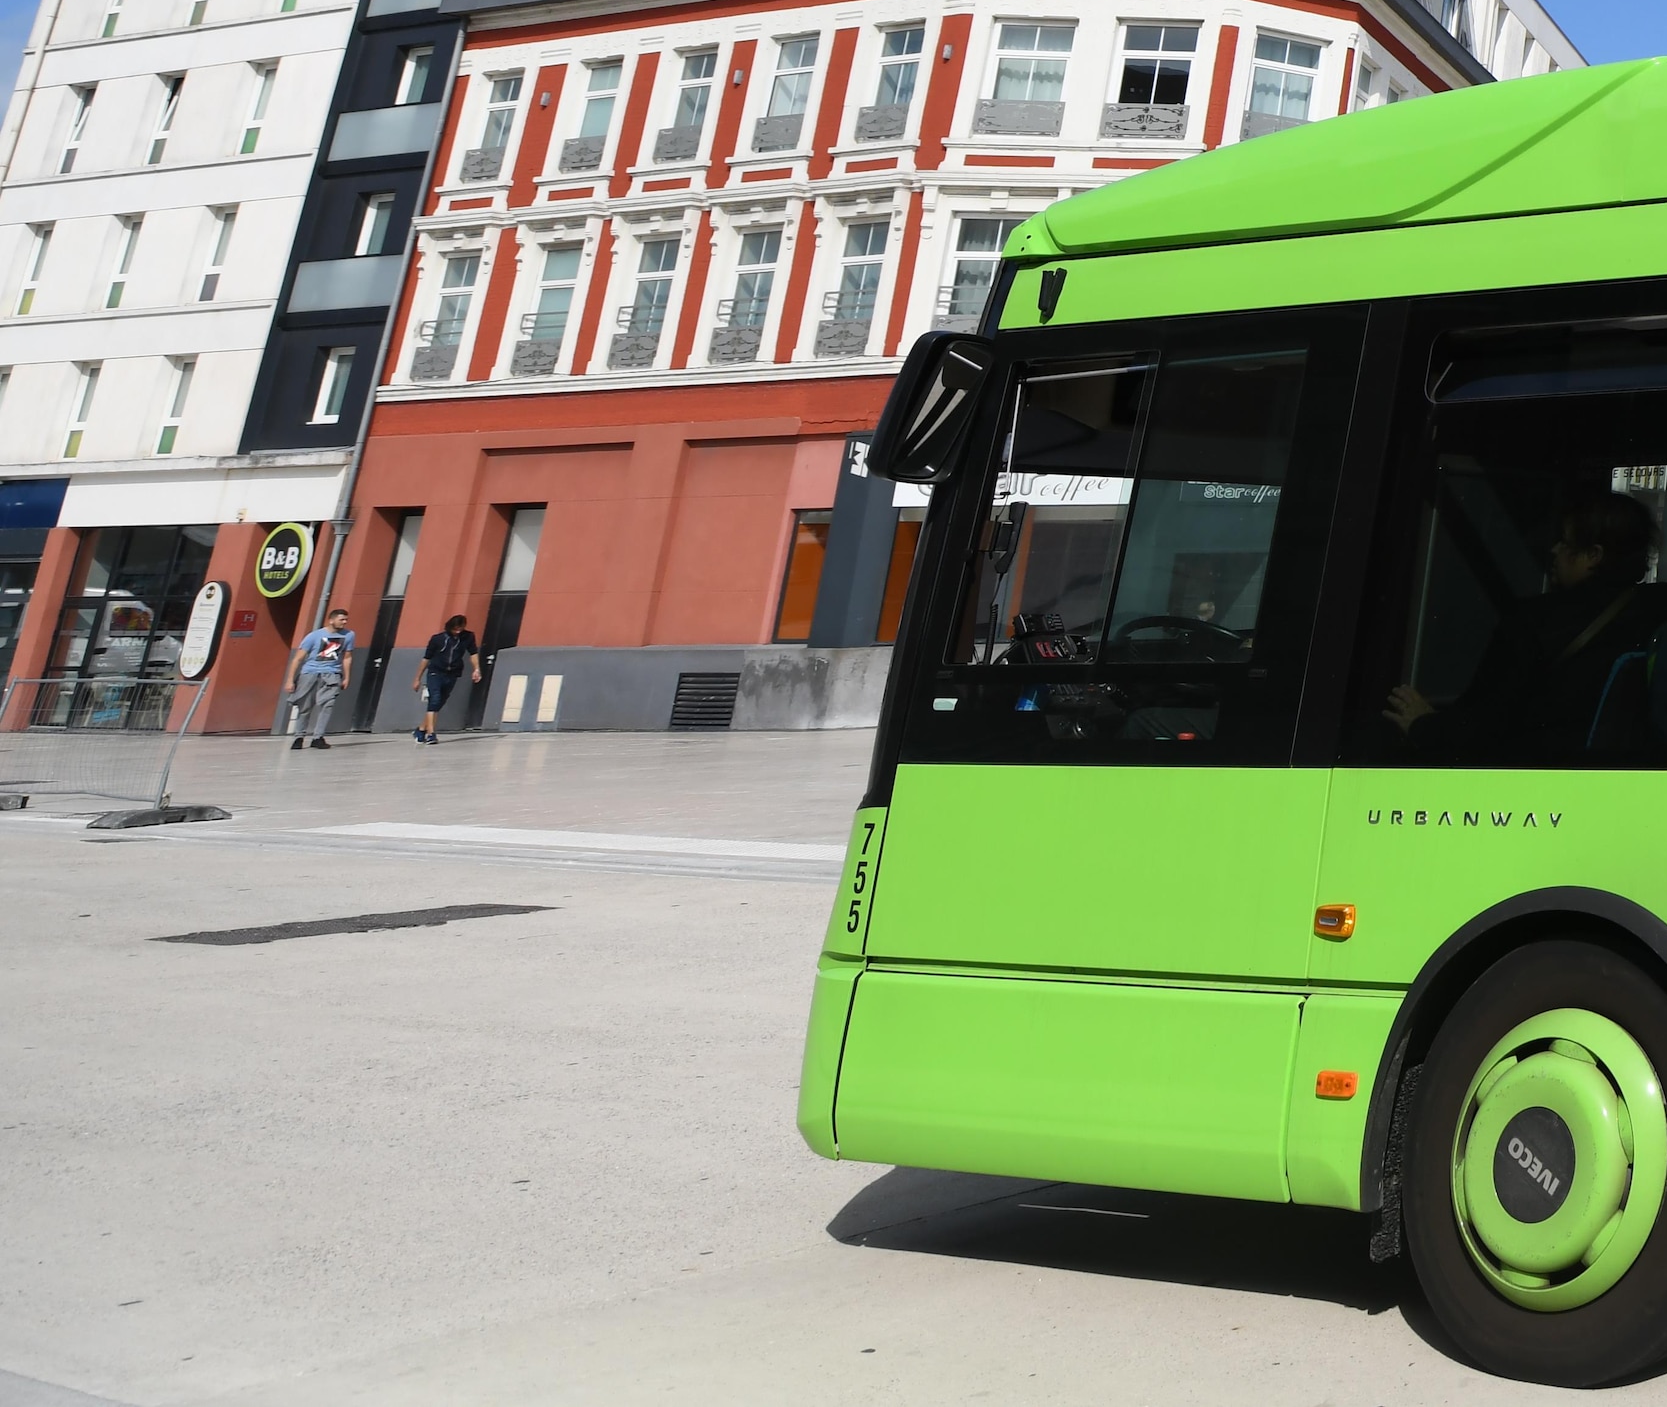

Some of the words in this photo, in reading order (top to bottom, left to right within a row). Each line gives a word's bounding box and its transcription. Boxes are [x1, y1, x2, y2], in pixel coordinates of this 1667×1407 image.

[261, 546, 299, 569] B&B
[263, 570, 290, 579] HOTELS
[243, 613, 255, 622] H
[1368, 809, 1562, 828] URBANWAY
[1508, 1137, 1560, 1196] IVECO
